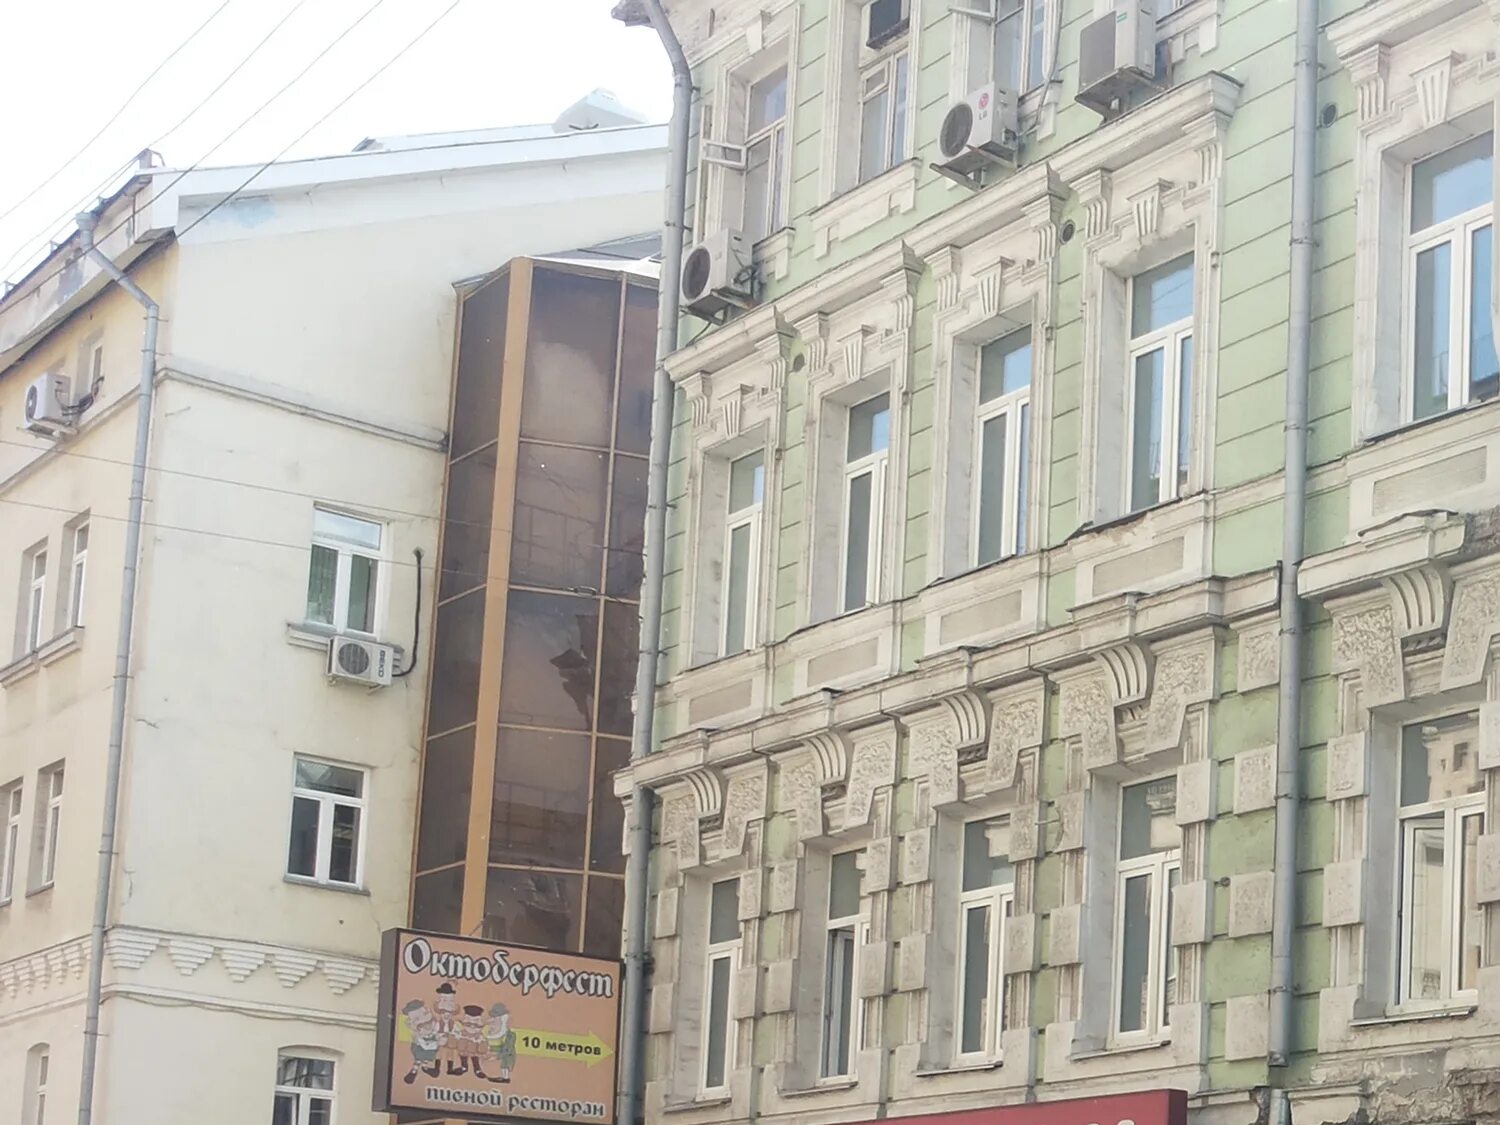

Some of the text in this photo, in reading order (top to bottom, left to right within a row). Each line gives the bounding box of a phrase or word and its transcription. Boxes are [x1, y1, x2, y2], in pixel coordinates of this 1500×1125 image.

[403, 937, 613, 998] Октоберфест
[522, 1036, 602, 1056] 10 метров
[426, 1086, 605, 1117] пивной ресторан
